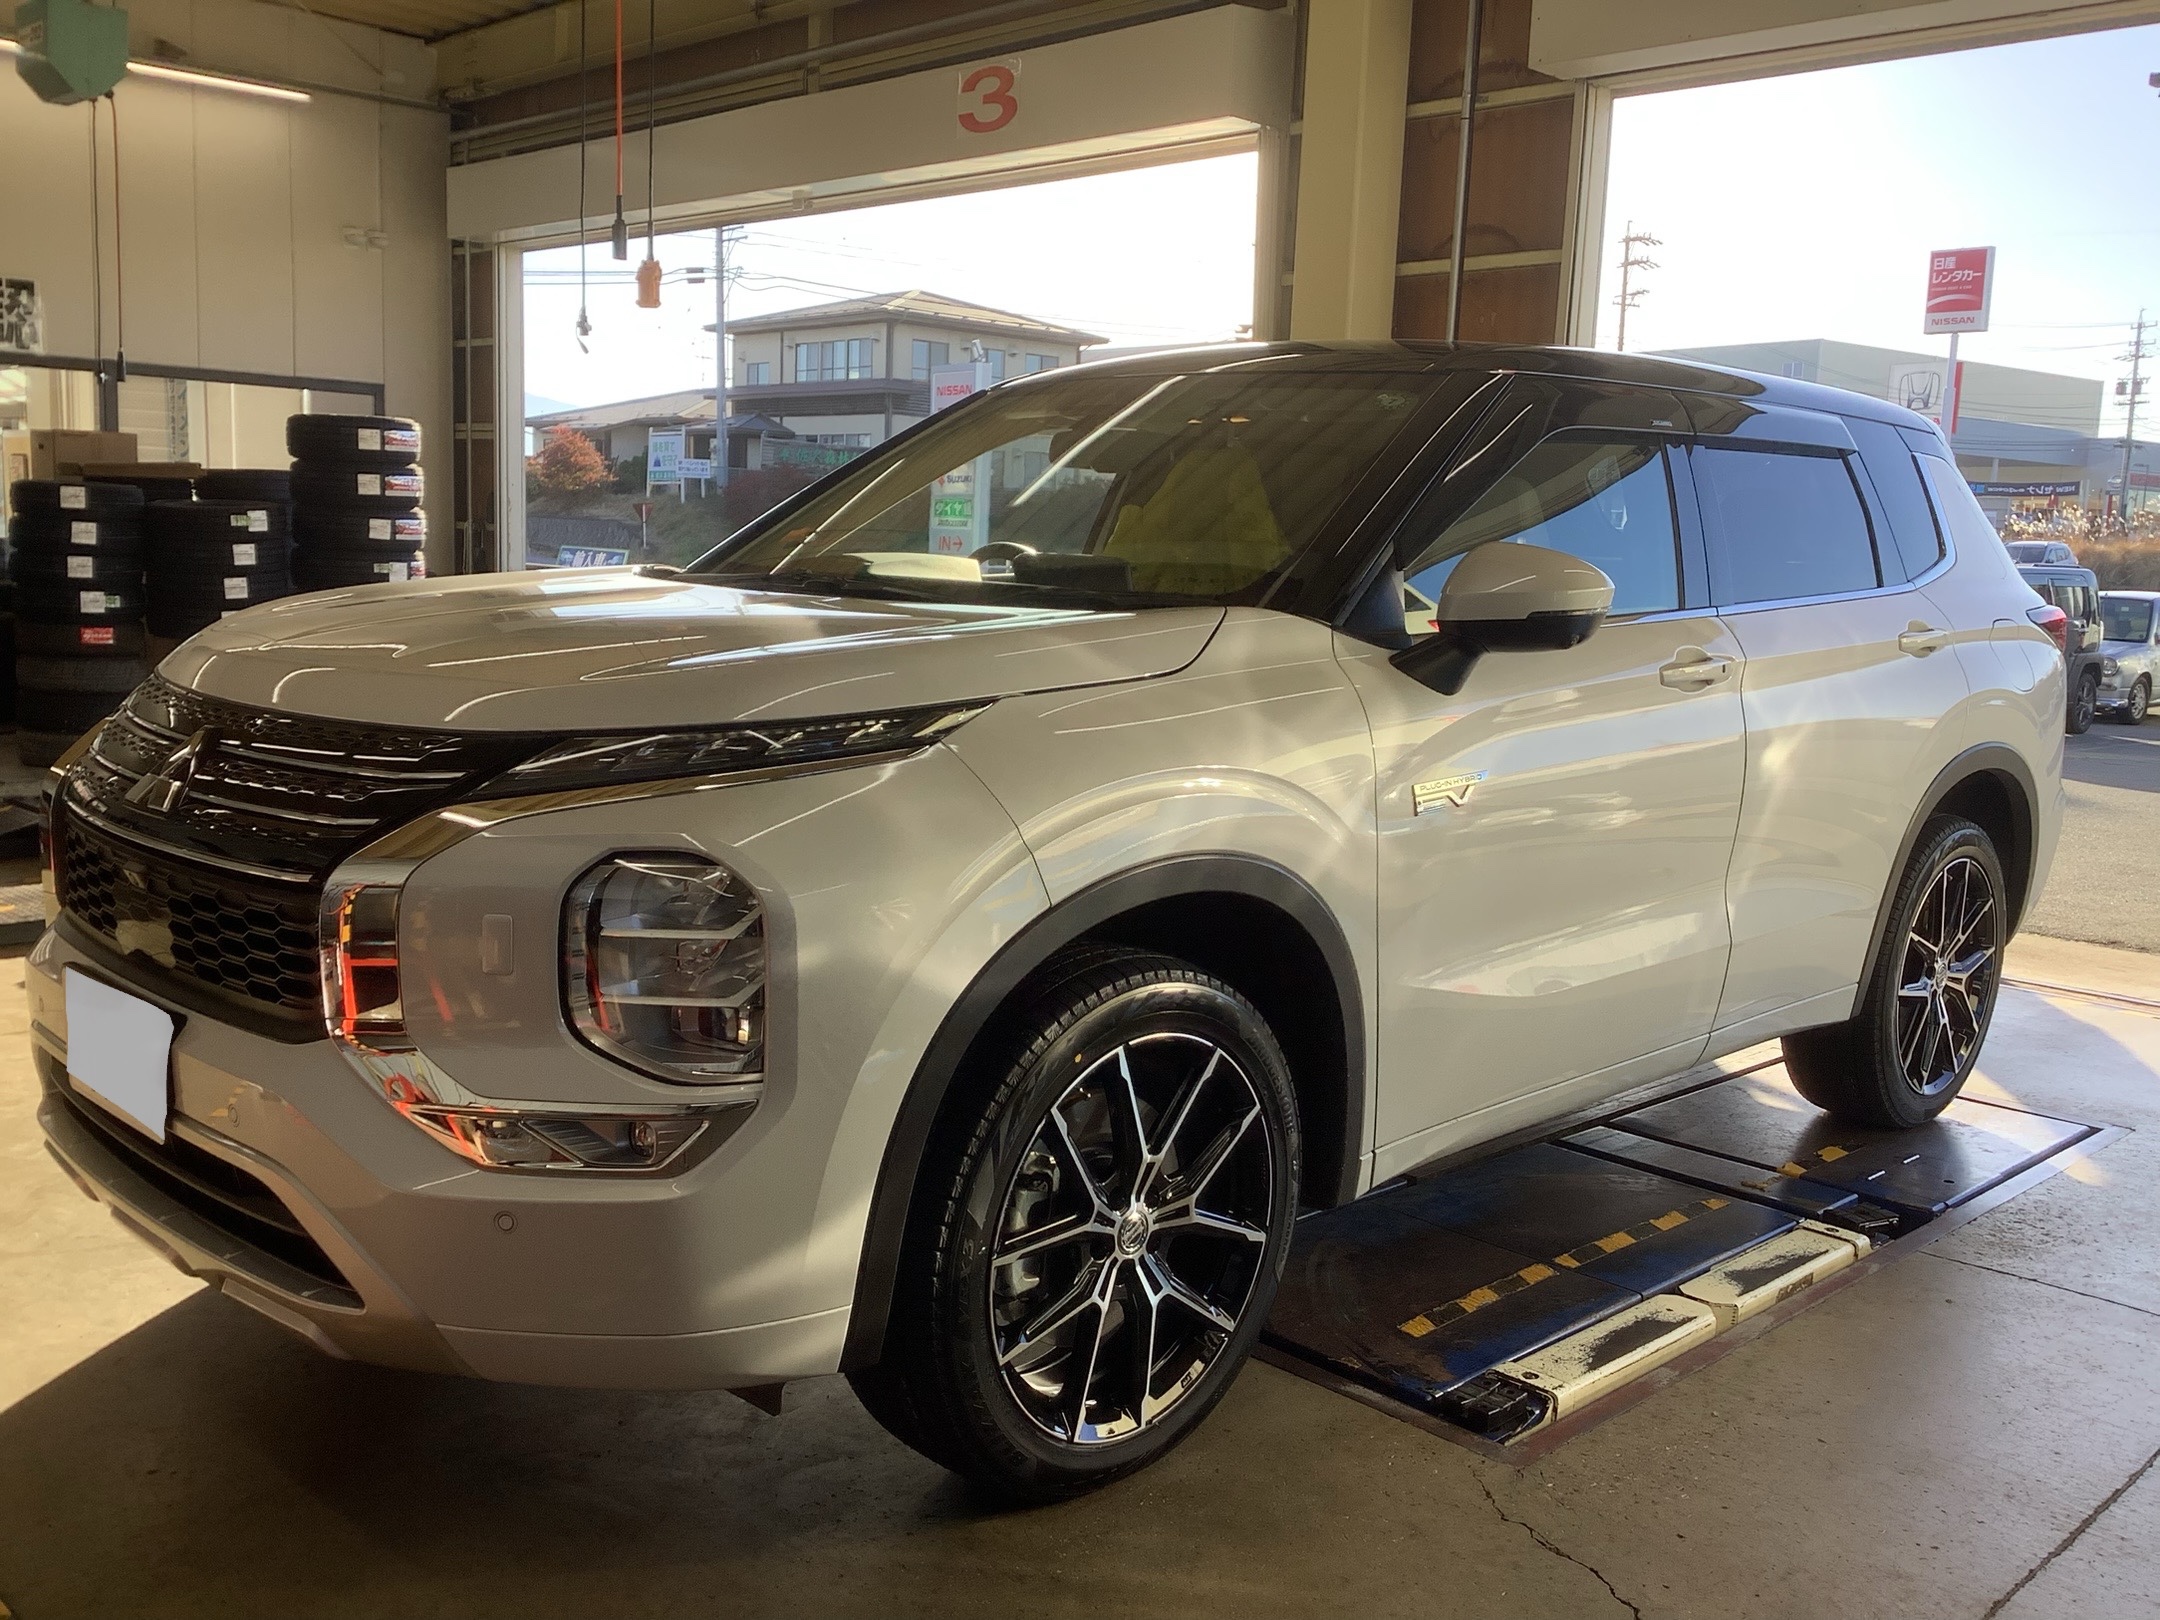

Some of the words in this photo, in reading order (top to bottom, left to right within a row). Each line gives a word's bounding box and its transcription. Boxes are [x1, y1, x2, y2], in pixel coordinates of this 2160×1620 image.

[958, 66, 1018, 133] 3
[1934, 257, 1956, 270] 日産
[1932, 269, 1982, 284] レンタカー
[1931, 316, 1975, 326] NISSAN
[936, 384, 973, 397] NISSAN
[798, 447, 860, 465] 佐久森林
[946, 474, 973, 484] SUZUKI
[935, 501, 972, 515] タイヤ
[939, 536, 951, 550] IN
